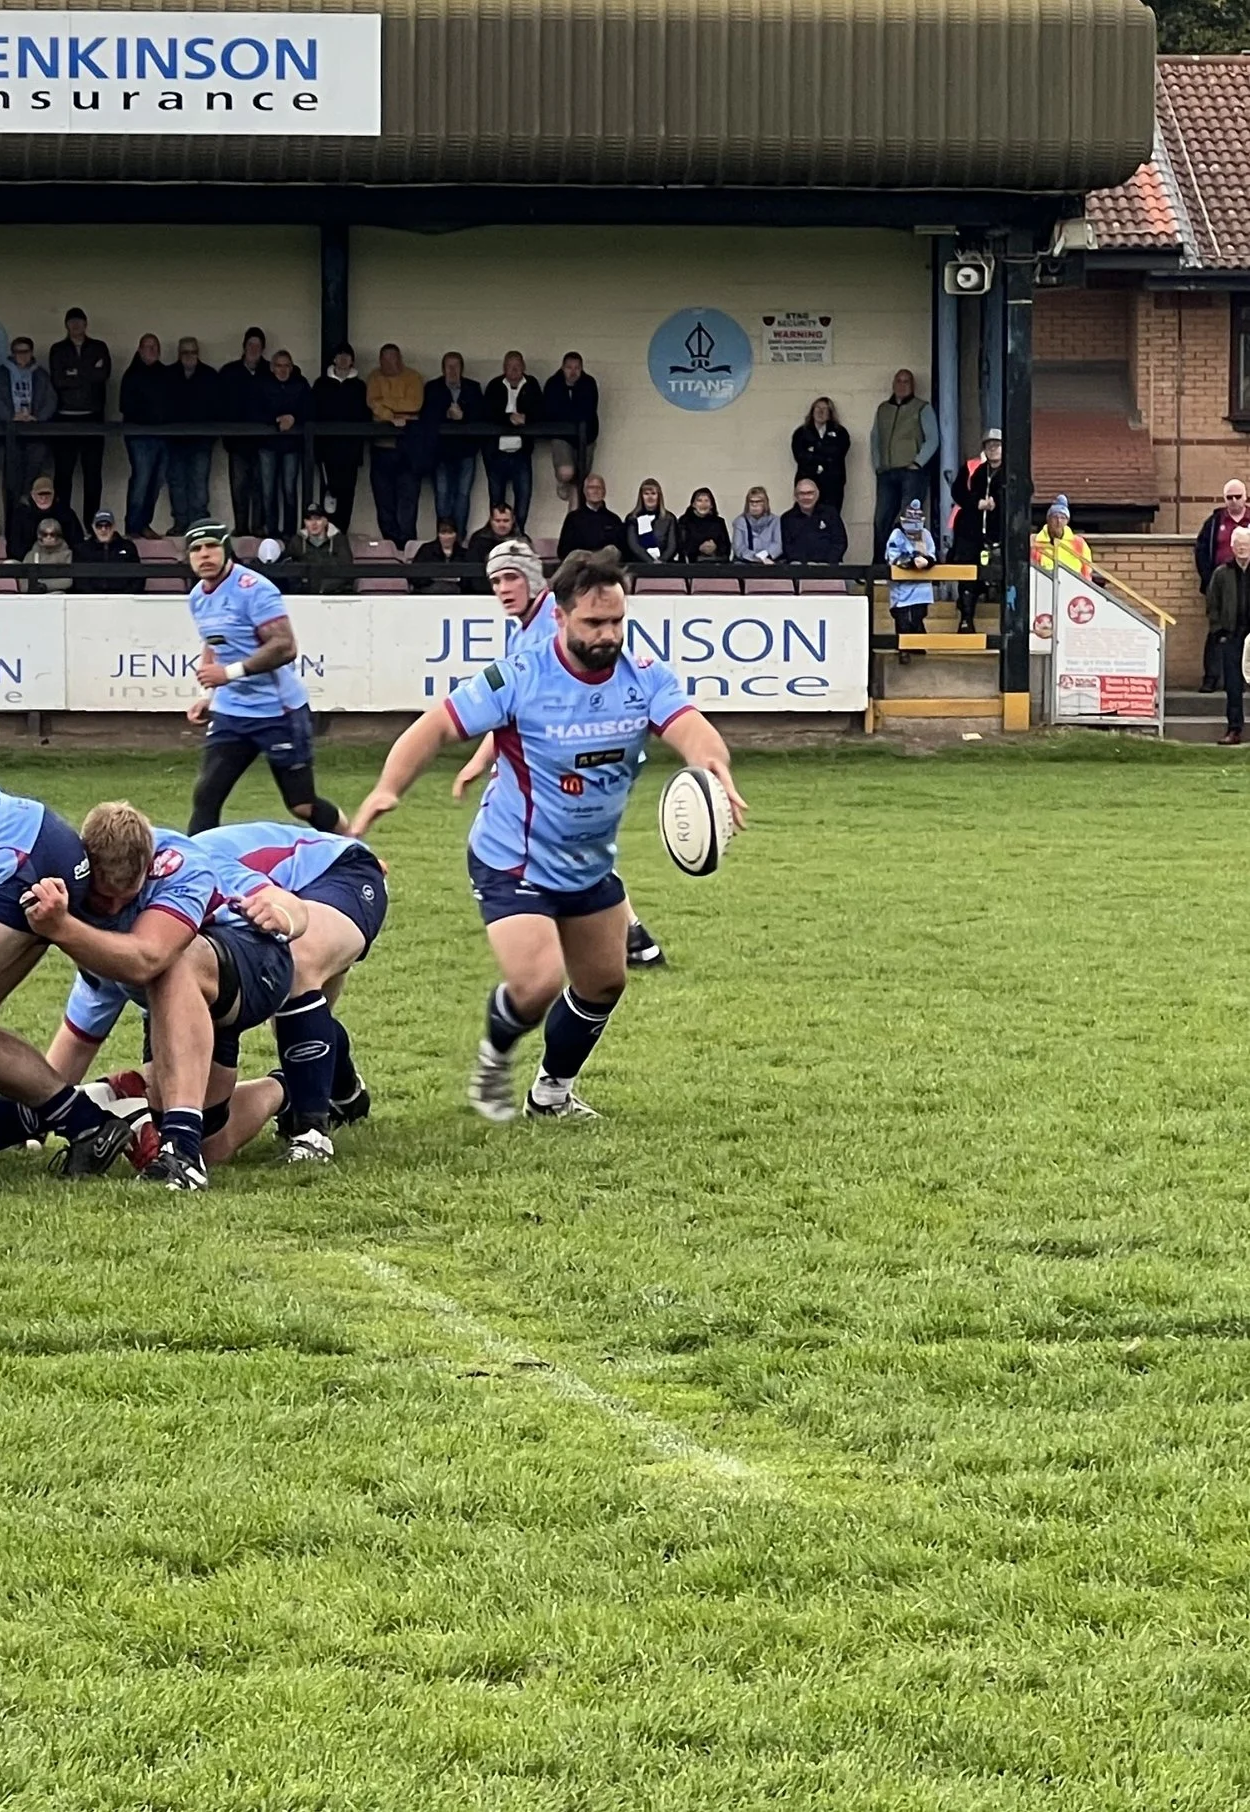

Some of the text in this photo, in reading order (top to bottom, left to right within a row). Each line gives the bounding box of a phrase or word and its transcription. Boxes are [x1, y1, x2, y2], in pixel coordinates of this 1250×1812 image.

[667, 379, 735, 393] TITANS
[545, 716, 649, 739] HARSCO
[675, 799, 690, 842] ROTH
